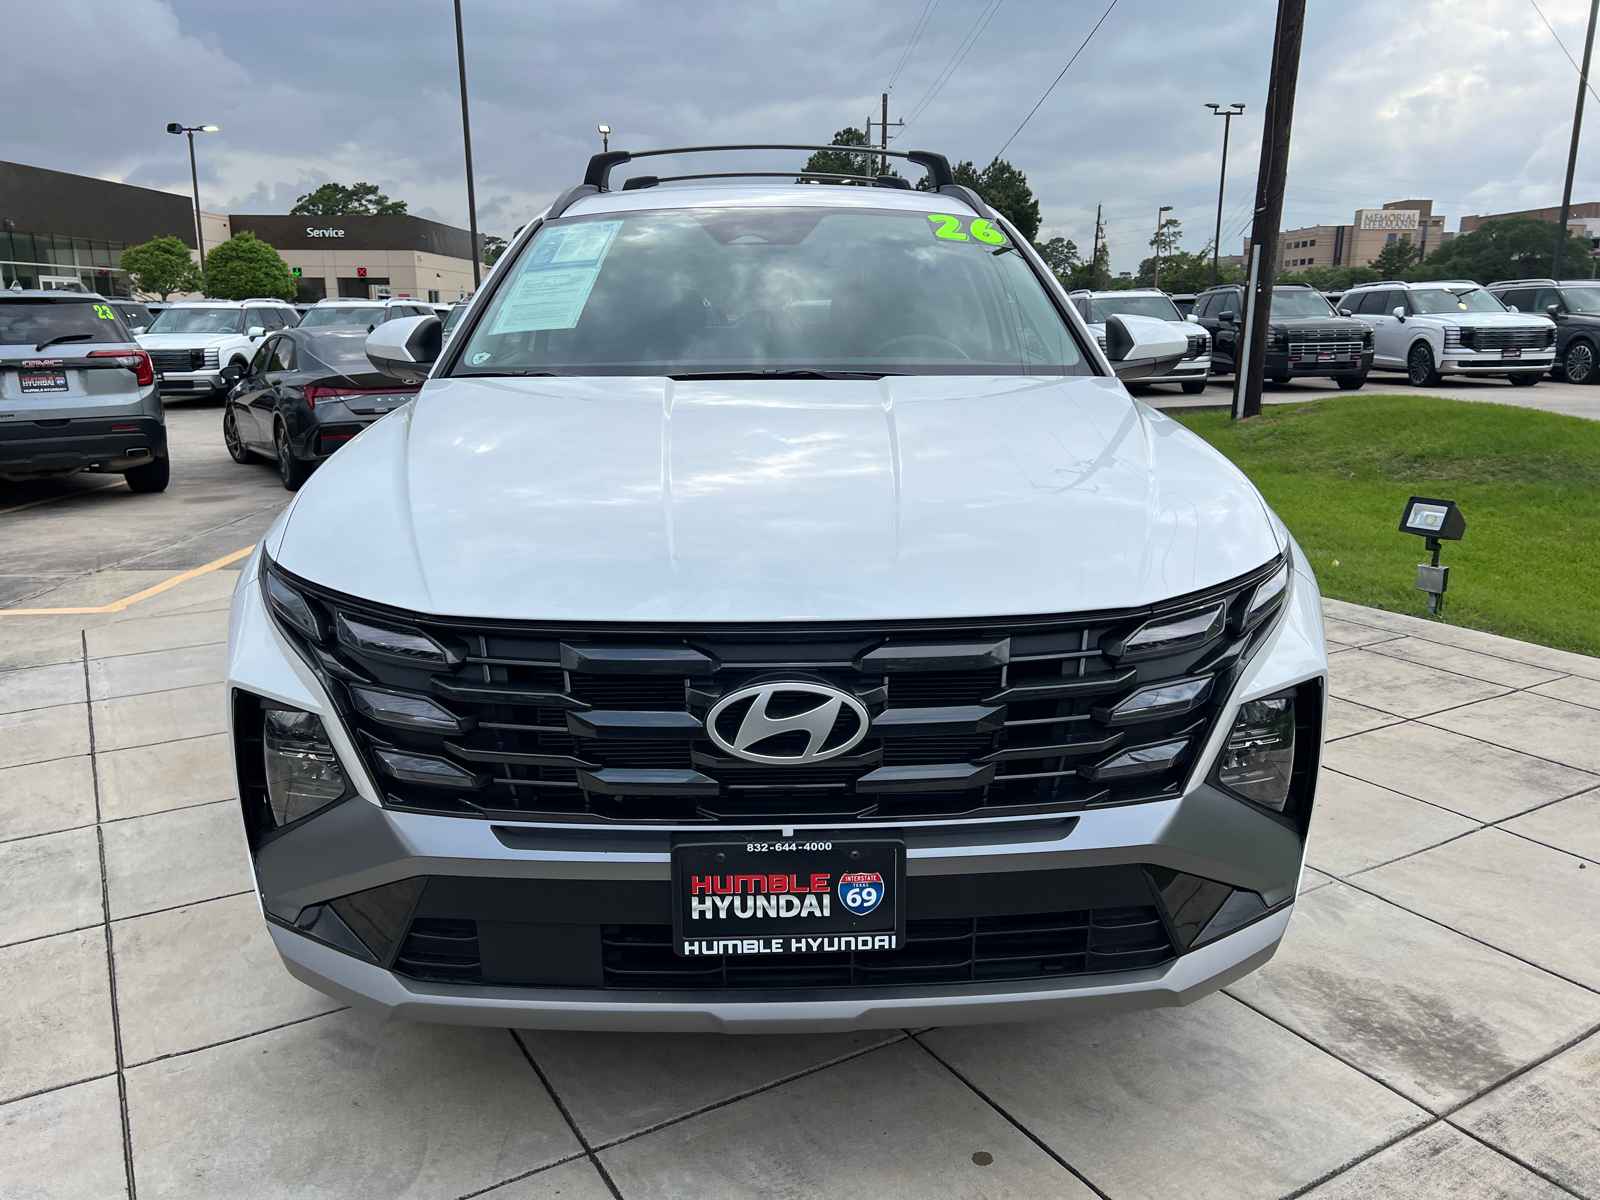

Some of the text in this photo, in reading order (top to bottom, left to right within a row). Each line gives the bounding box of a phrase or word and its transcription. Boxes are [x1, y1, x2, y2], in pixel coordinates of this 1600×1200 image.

[1363, 220, 1417, 229] HERMANN
[1364, 212, 1417, 222] MEMORIAL
[306, 227, 345, 238] Service
[927, 214, 1007, 245] 26
[93, 304, 115, 320] 23
[22, 359, 63, 368] GMC
[746, 842, 833, 852] 832-644-4000
[691, 873, 831, 895] HUMBLE
[846, 887, 877, 908] 69
[691, 893, 831, 920] HYUNDAI
[684, 935, 896, 955] HUMBLE HYUNDAI
